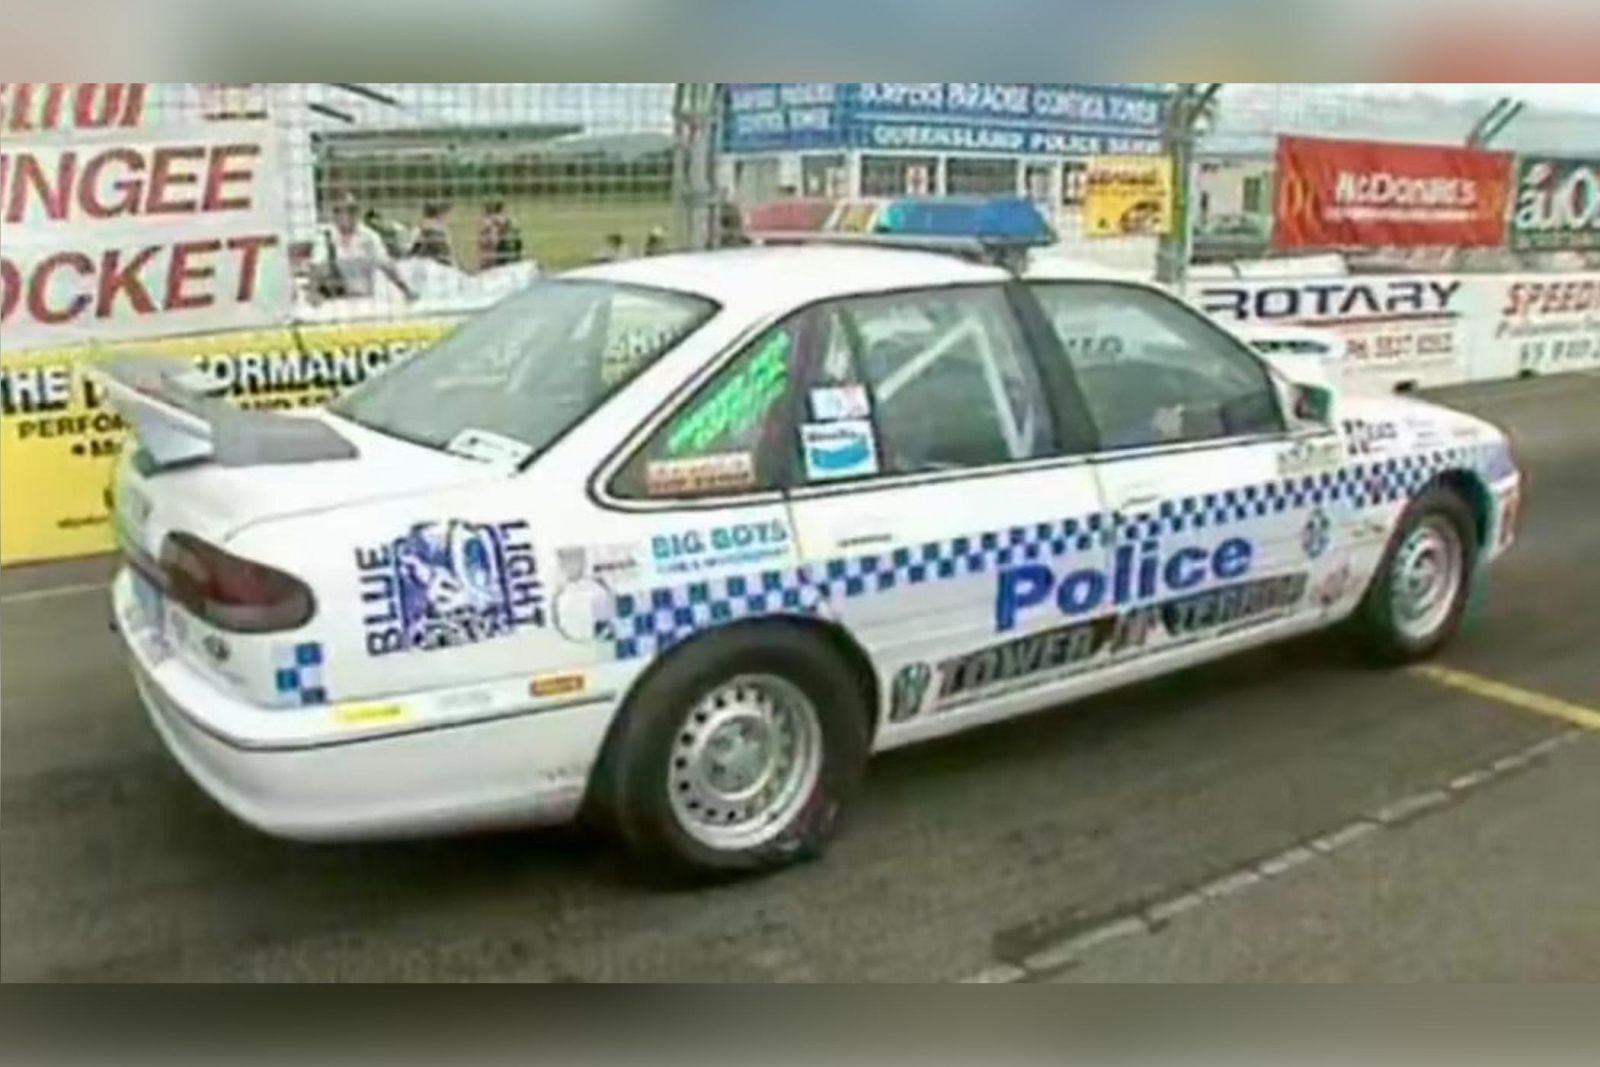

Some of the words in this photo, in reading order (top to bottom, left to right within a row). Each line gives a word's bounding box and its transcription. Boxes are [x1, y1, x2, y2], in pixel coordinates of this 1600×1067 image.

[873, 124, 1023, 150] QUEENSLAND
[1030, 131, 1100, 153] POLICE
[0, 144, 261, 223] NGEE
[1200, 280, 1462, 321] ROTARY
[499, 519, 546, 628] LIGHT
[651, 529, 706, 560] BIG
[710, 518, 788, 551] BOYS
[354, 542, 402, 656] BLUE
[995, 536, 1253, 633] Police
